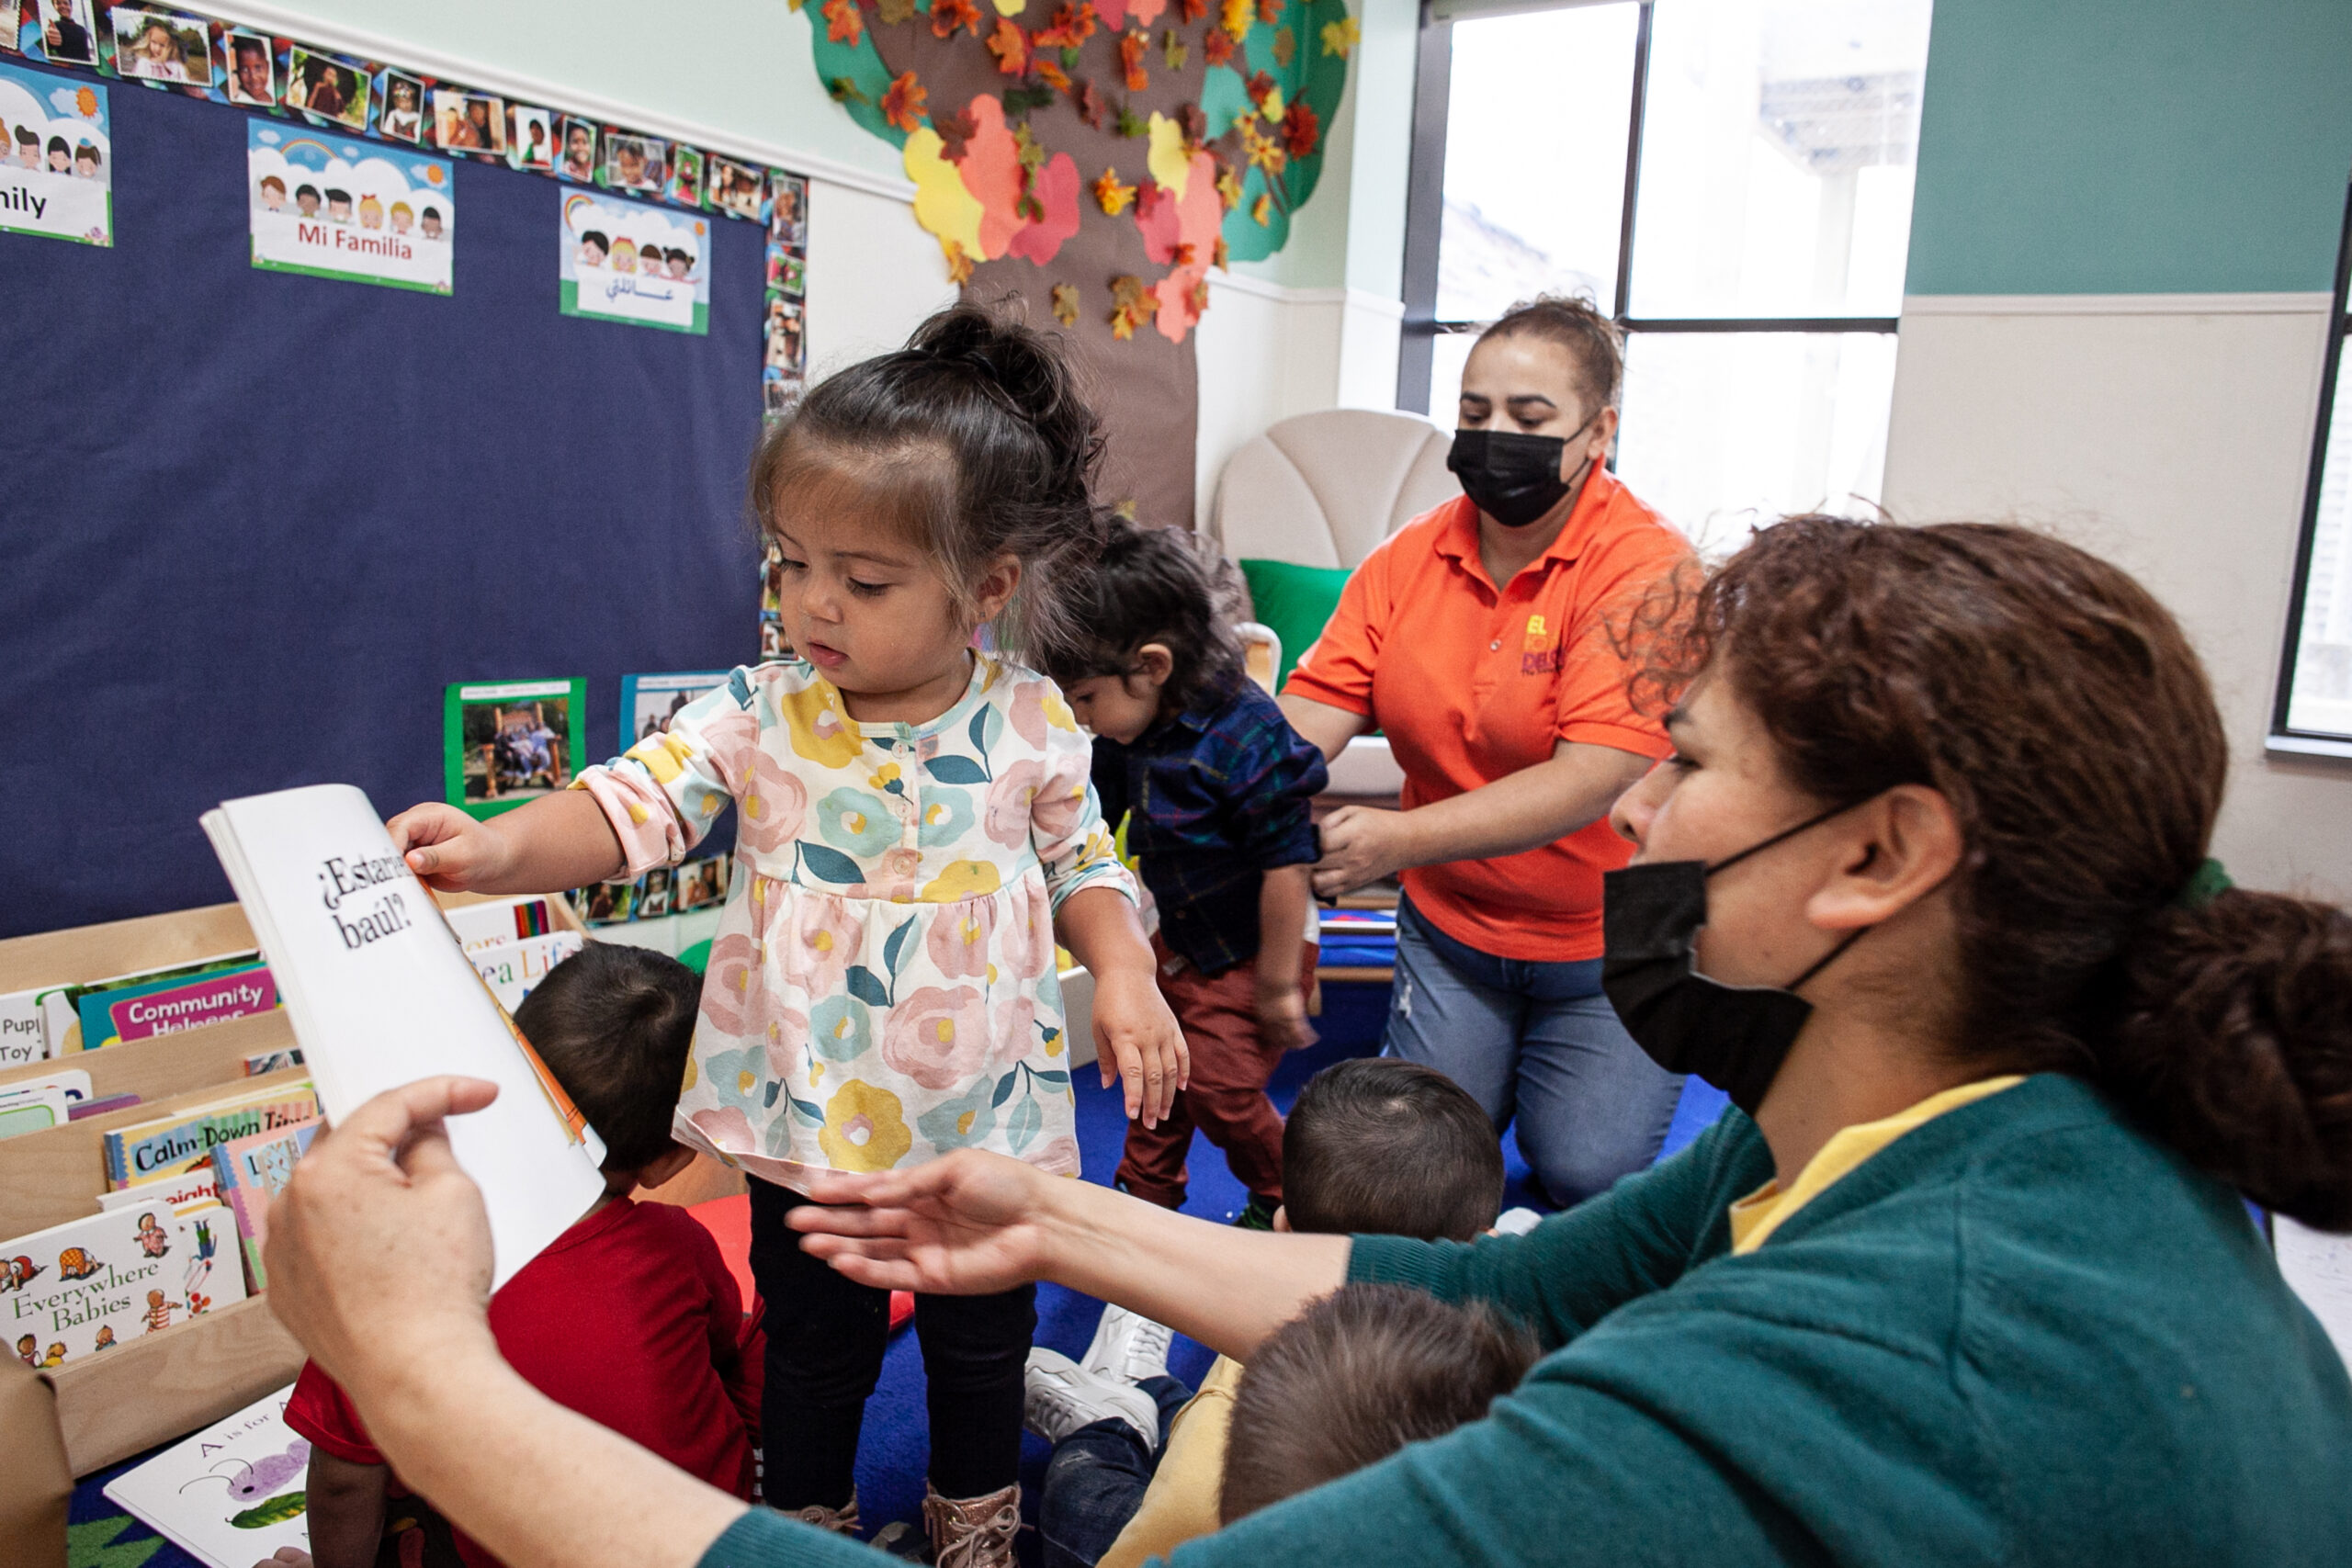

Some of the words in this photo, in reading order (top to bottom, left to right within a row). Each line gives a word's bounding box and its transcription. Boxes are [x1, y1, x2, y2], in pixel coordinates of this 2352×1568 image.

[298, 221, 327, 247] Mi
[335, 229, 413, 260] Familia
[1526, 614, 1547, 636] EL
[332, 893, 412, 949] baúl?
[477, 961, 514, 985] ea
[129, 984, 264, 1024] Community
[3, 1017, 40, 1035] Pup
[0, 1044, 32, 1063] Toy
[136, 1120, 260, 1172] Calm-Down
[12, 1263, 160, 1320] Everywhere
[51, 1294, 131, 1332] Babies
[201, 1443, 225, 1458] A
[223, 1430, 243, 1440] is
[243, 1414, 270, 1430] for
